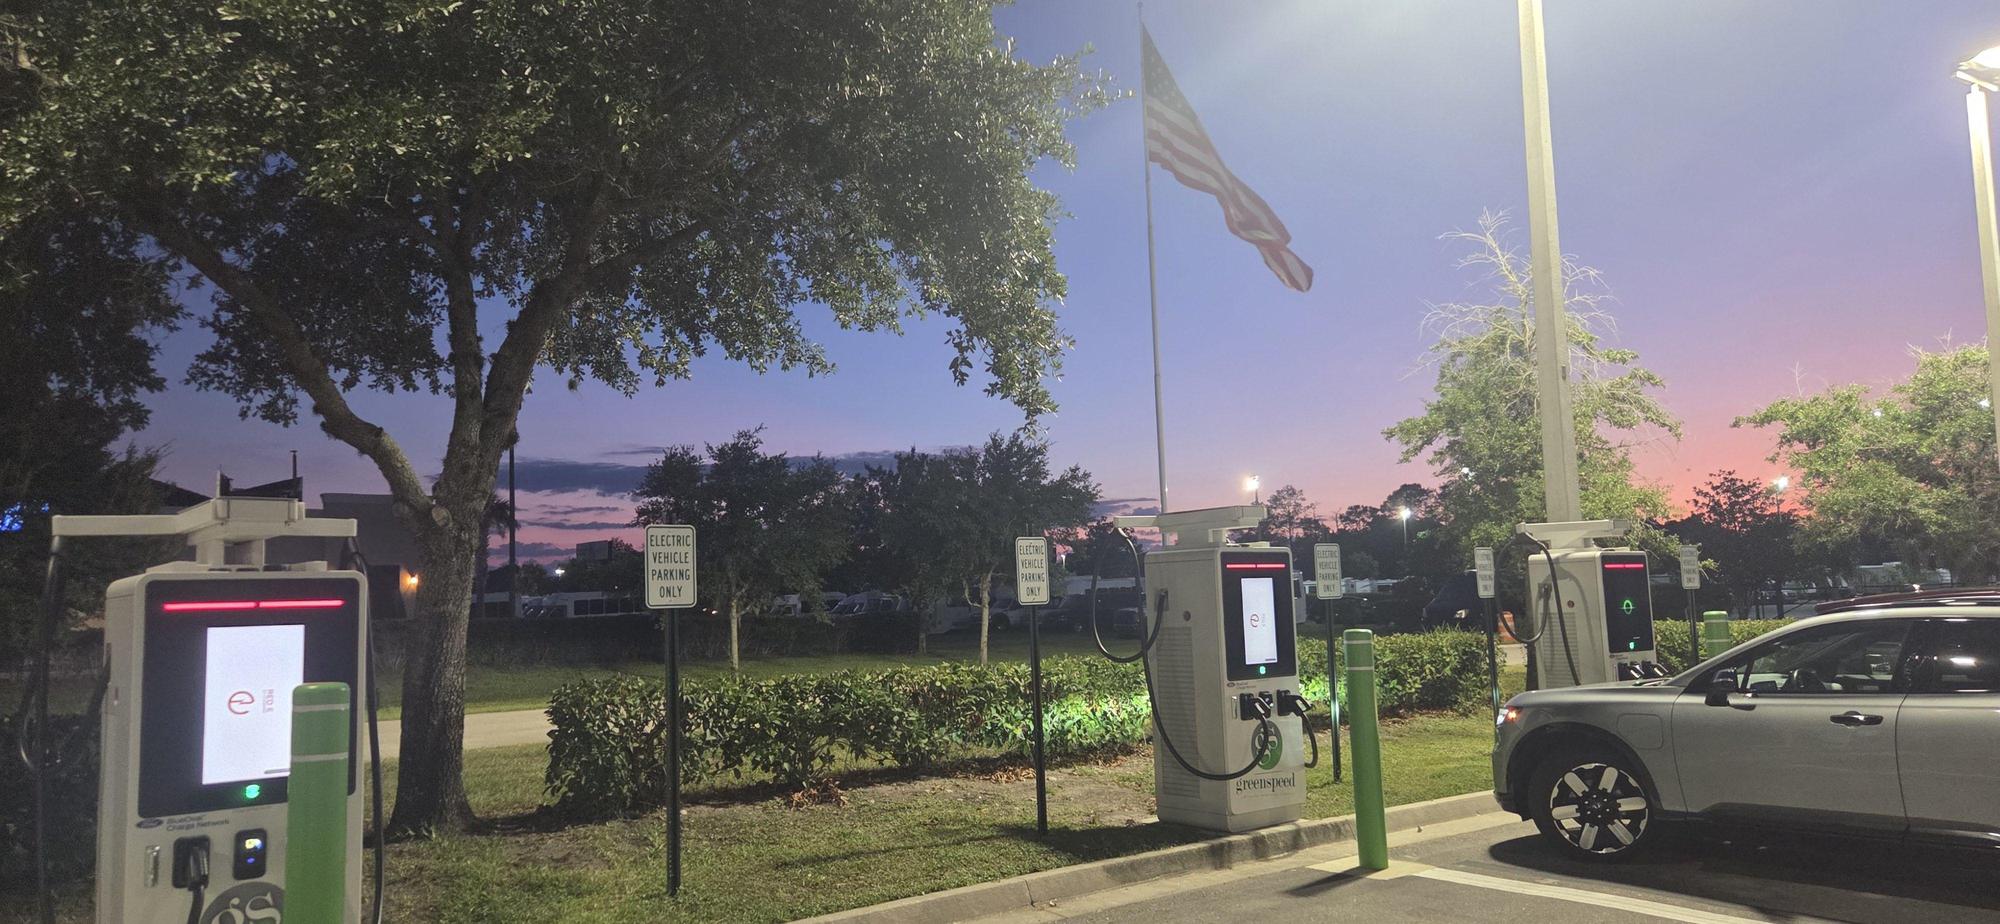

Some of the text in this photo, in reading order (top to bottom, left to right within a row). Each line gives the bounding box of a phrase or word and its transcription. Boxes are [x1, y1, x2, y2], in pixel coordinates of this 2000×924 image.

[649, 534, 691, 547] ELECTRIC
[1019, 544, 1044, 556] ELECTRIC
[652, 551, 689, 564] VEHICLE
[1020, 558, 1044, 569] VEHICLE
[651, 568, 690, 581] PARKING
[1020, 572, 1045, 582] PARKING
[659, 585, 682, 598] ONLY
[1025, 586, 1041, 597] ONLY
[1235, 771, 1295, 794] greenspeed
